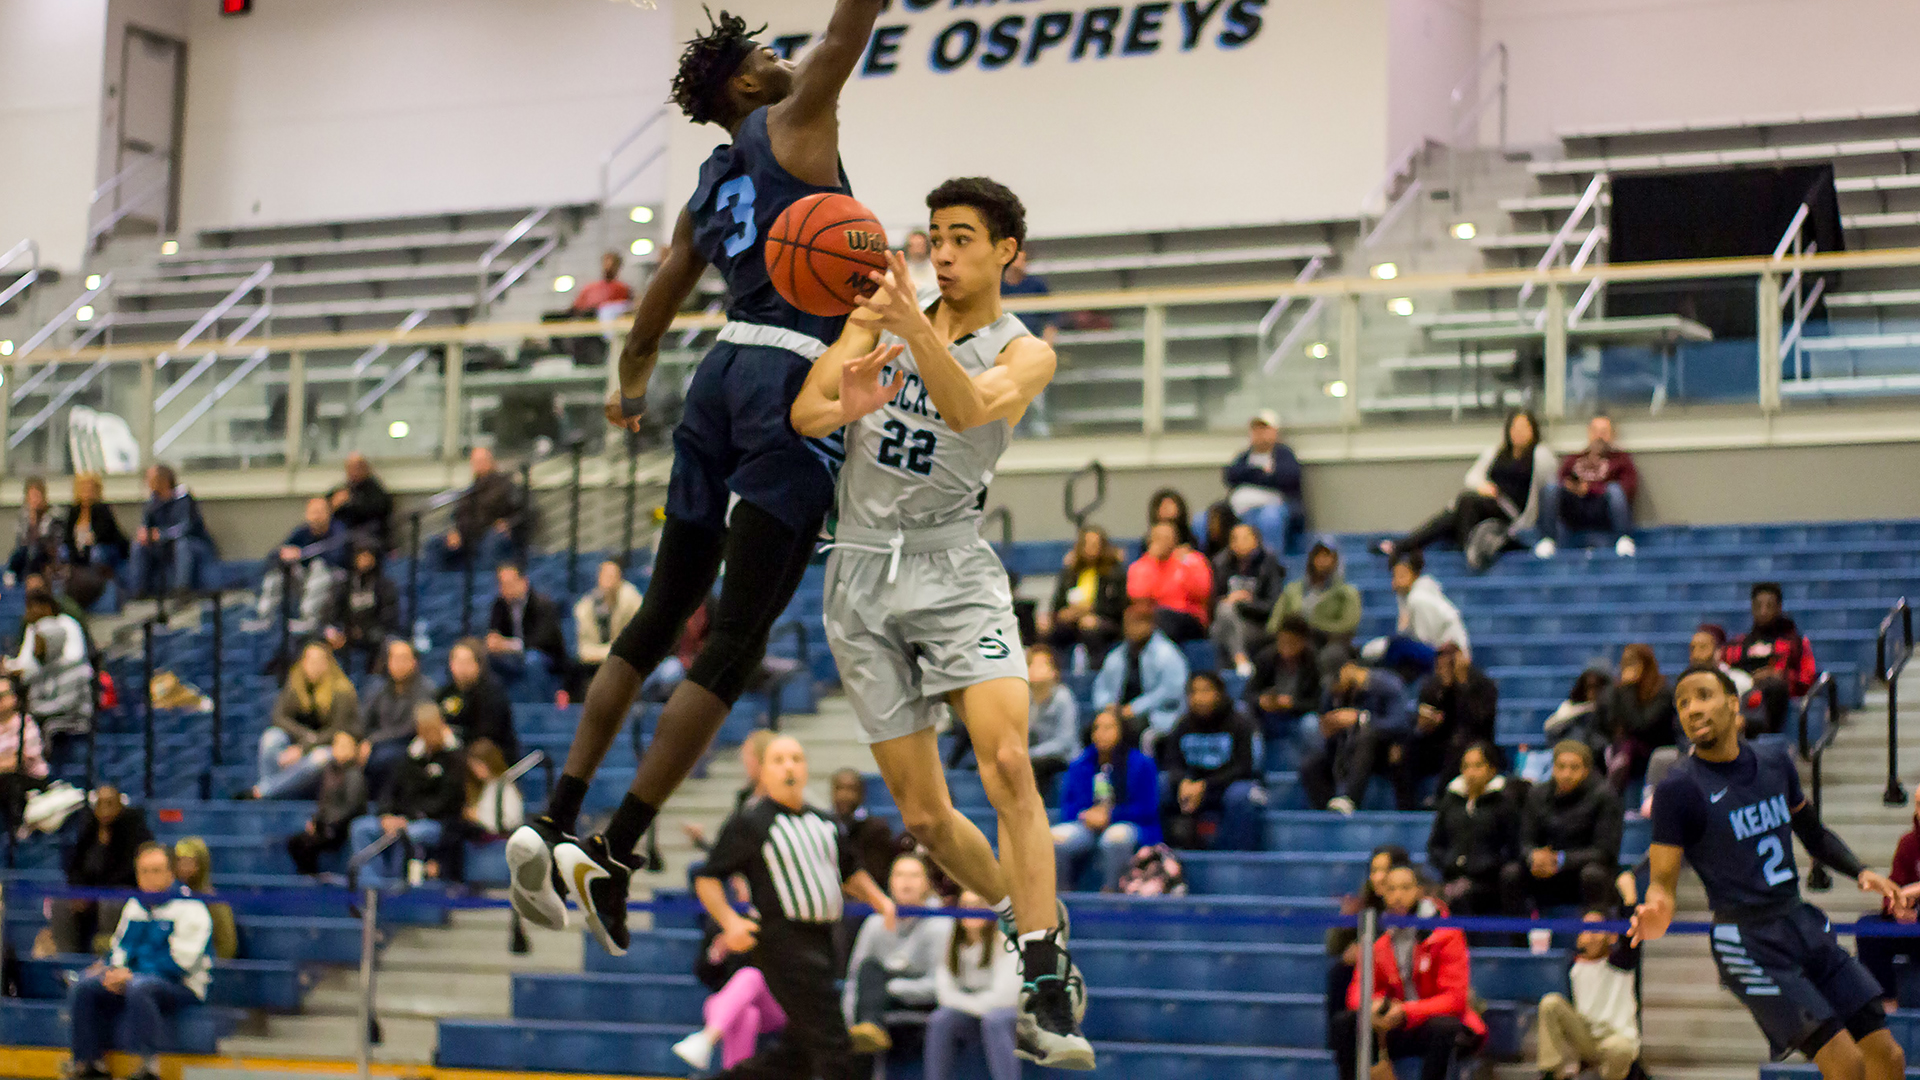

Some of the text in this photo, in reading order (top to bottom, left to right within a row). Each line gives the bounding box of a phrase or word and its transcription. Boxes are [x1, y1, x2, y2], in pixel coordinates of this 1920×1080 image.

[770, 0, 1267, 77] TE OSPREYS
[716, 175, 758, 258] 3
[877, 419, 937, 476] 22
[1729, 793, 1791, 841] KEAN
[1757, 834, 1794, 887] 2
